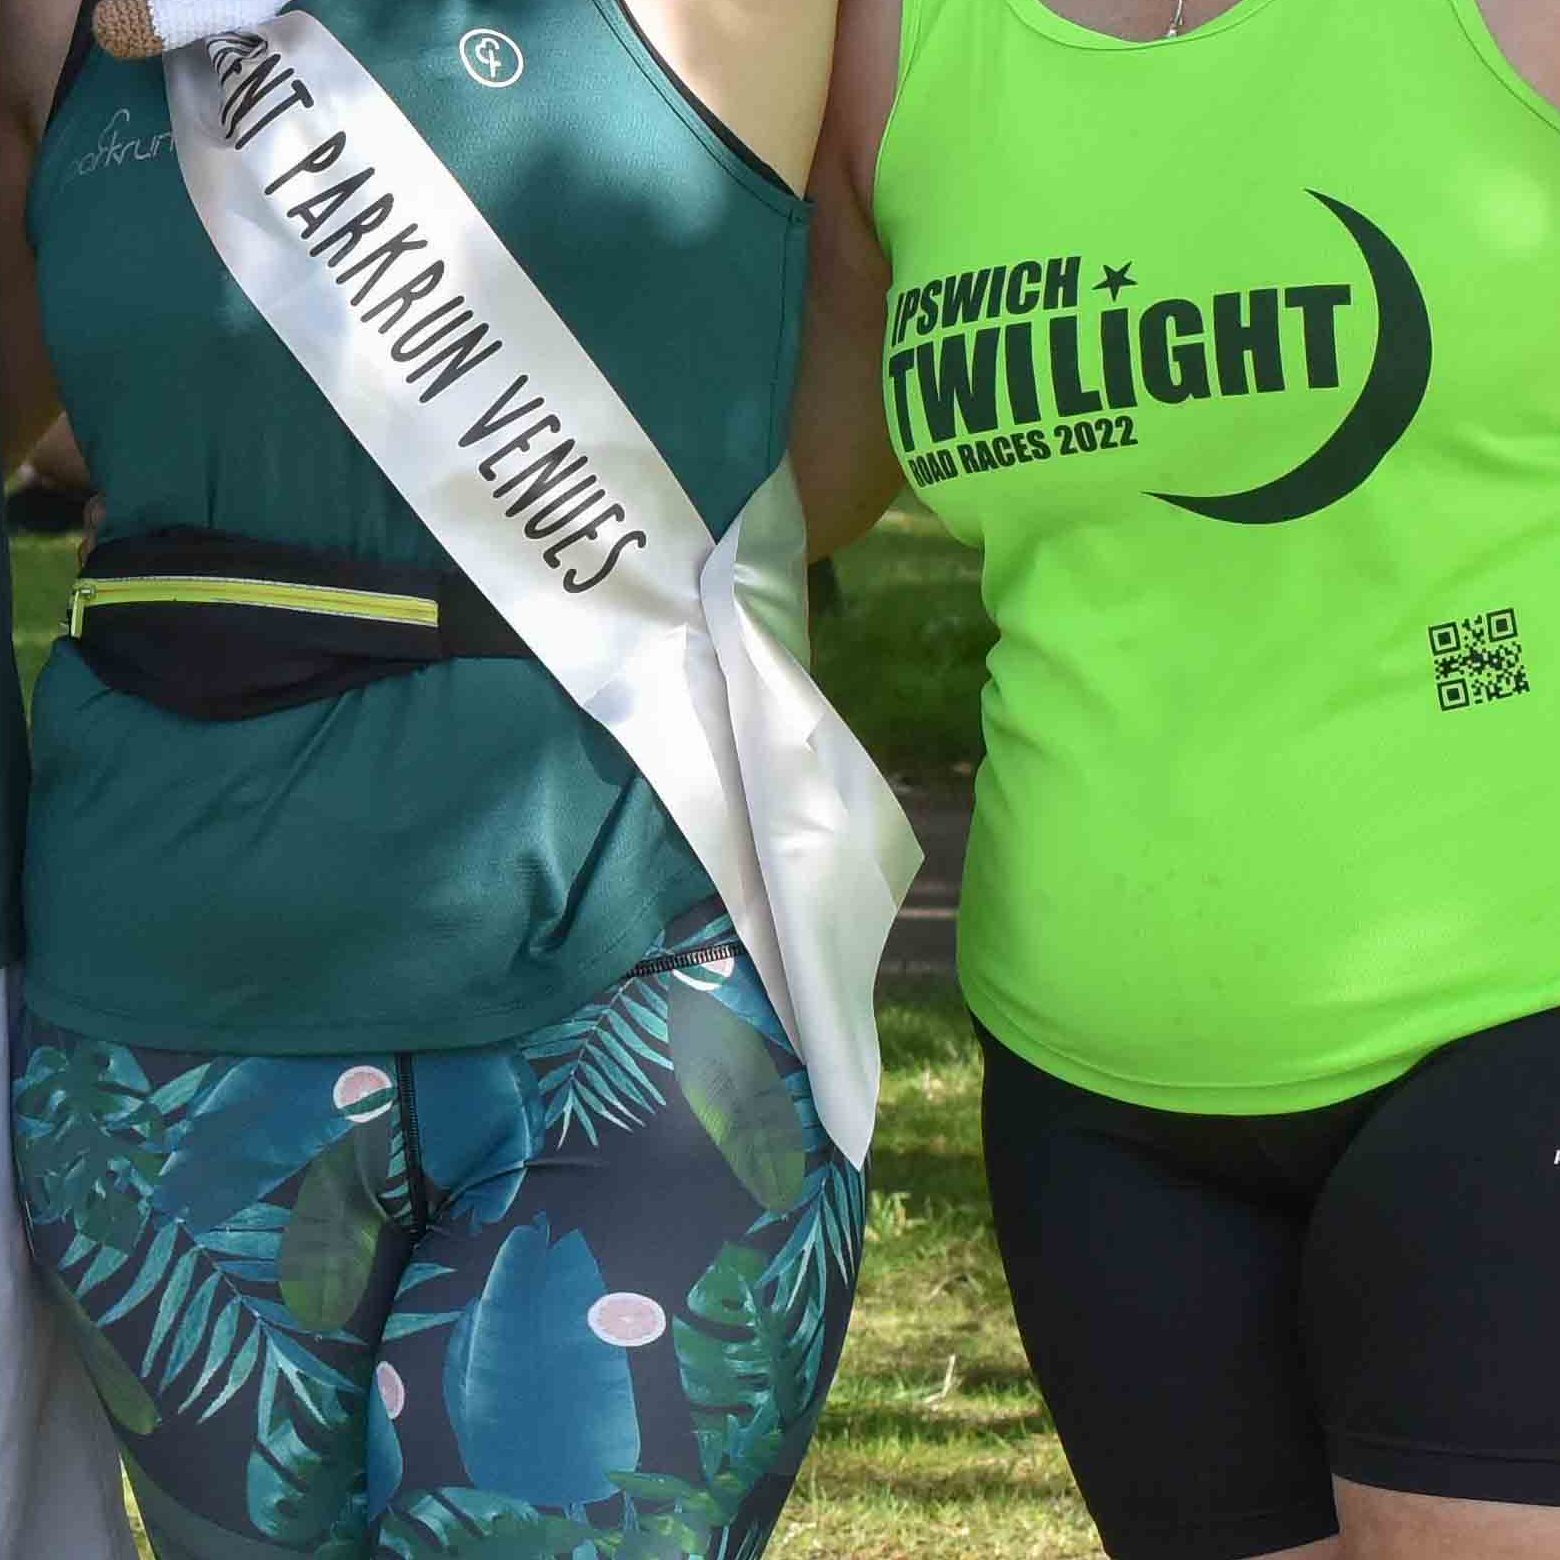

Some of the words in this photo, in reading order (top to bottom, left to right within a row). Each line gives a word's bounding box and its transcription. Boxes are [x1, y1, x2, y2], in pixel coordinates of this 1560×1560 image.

[264, 130, 504, 404] PARKRUN
[458, 374, 648, 595] VENUES
[892, 256, 1081, 343] IPSWICH
[888, 283, 1352, 453] TWILIGHT
[909, 446, 959, 488] ROAD
[961, 430, 1051, 479] RACES
[1053, 415, 1138, 458] 2022
